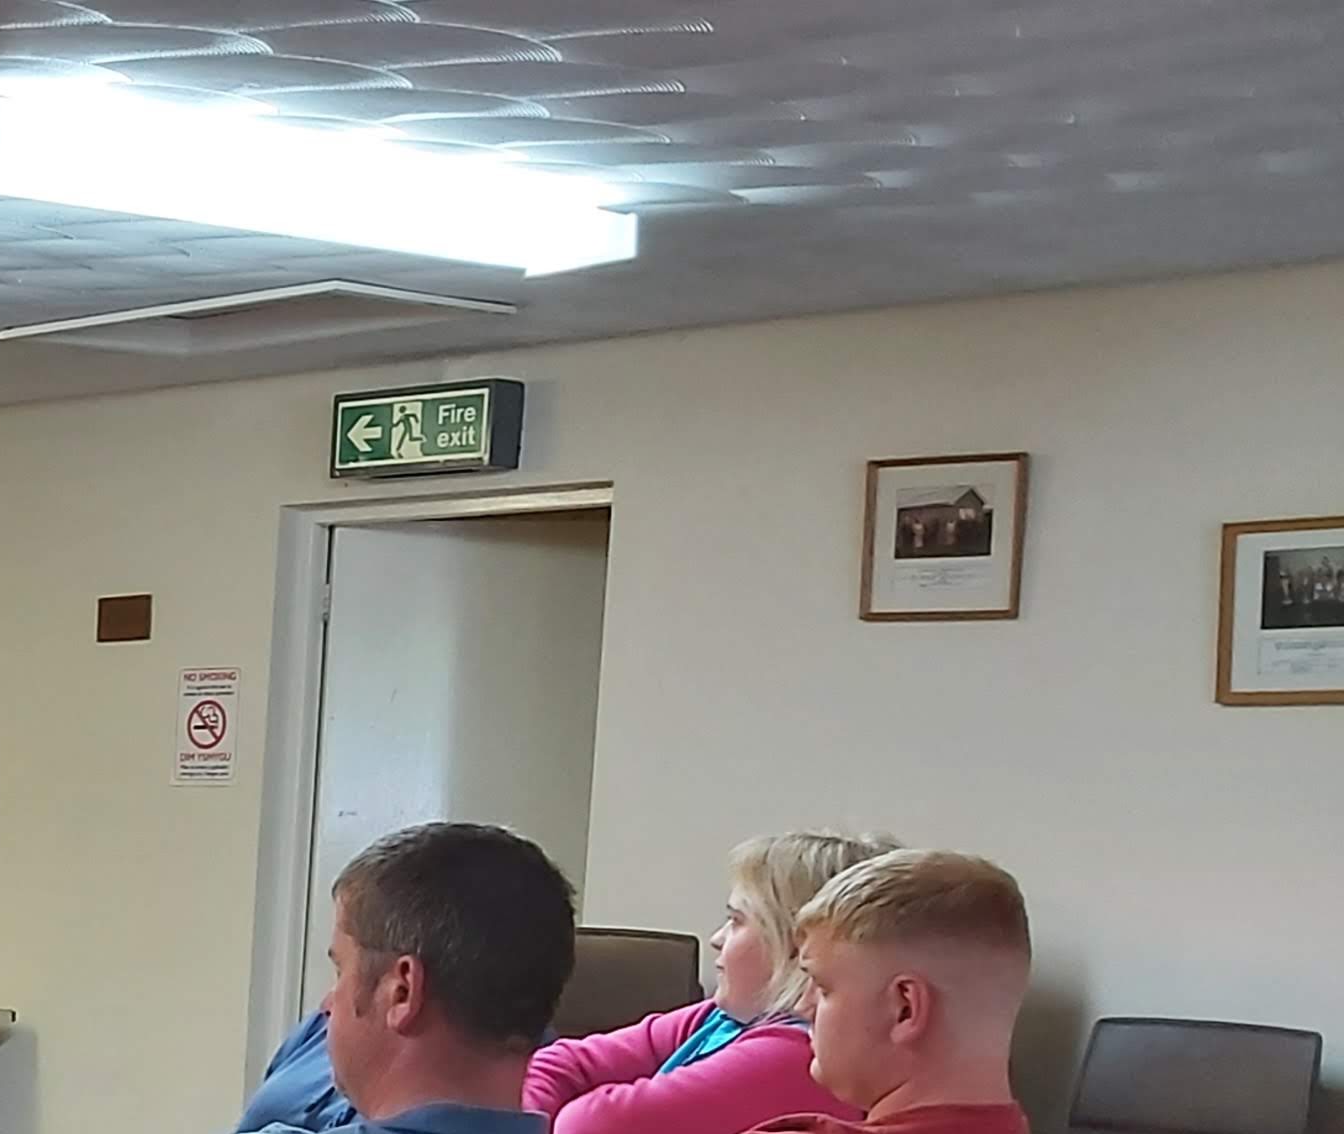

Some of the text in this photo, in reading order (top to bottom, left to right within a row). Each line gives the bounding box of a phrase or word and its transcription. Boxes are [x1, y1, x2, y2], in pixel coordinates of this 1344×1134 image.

[438, 404, 476, 424] Fire
[437, 426, 476, 447] exit
[183, 672, 237, 682] NO SMOKING
